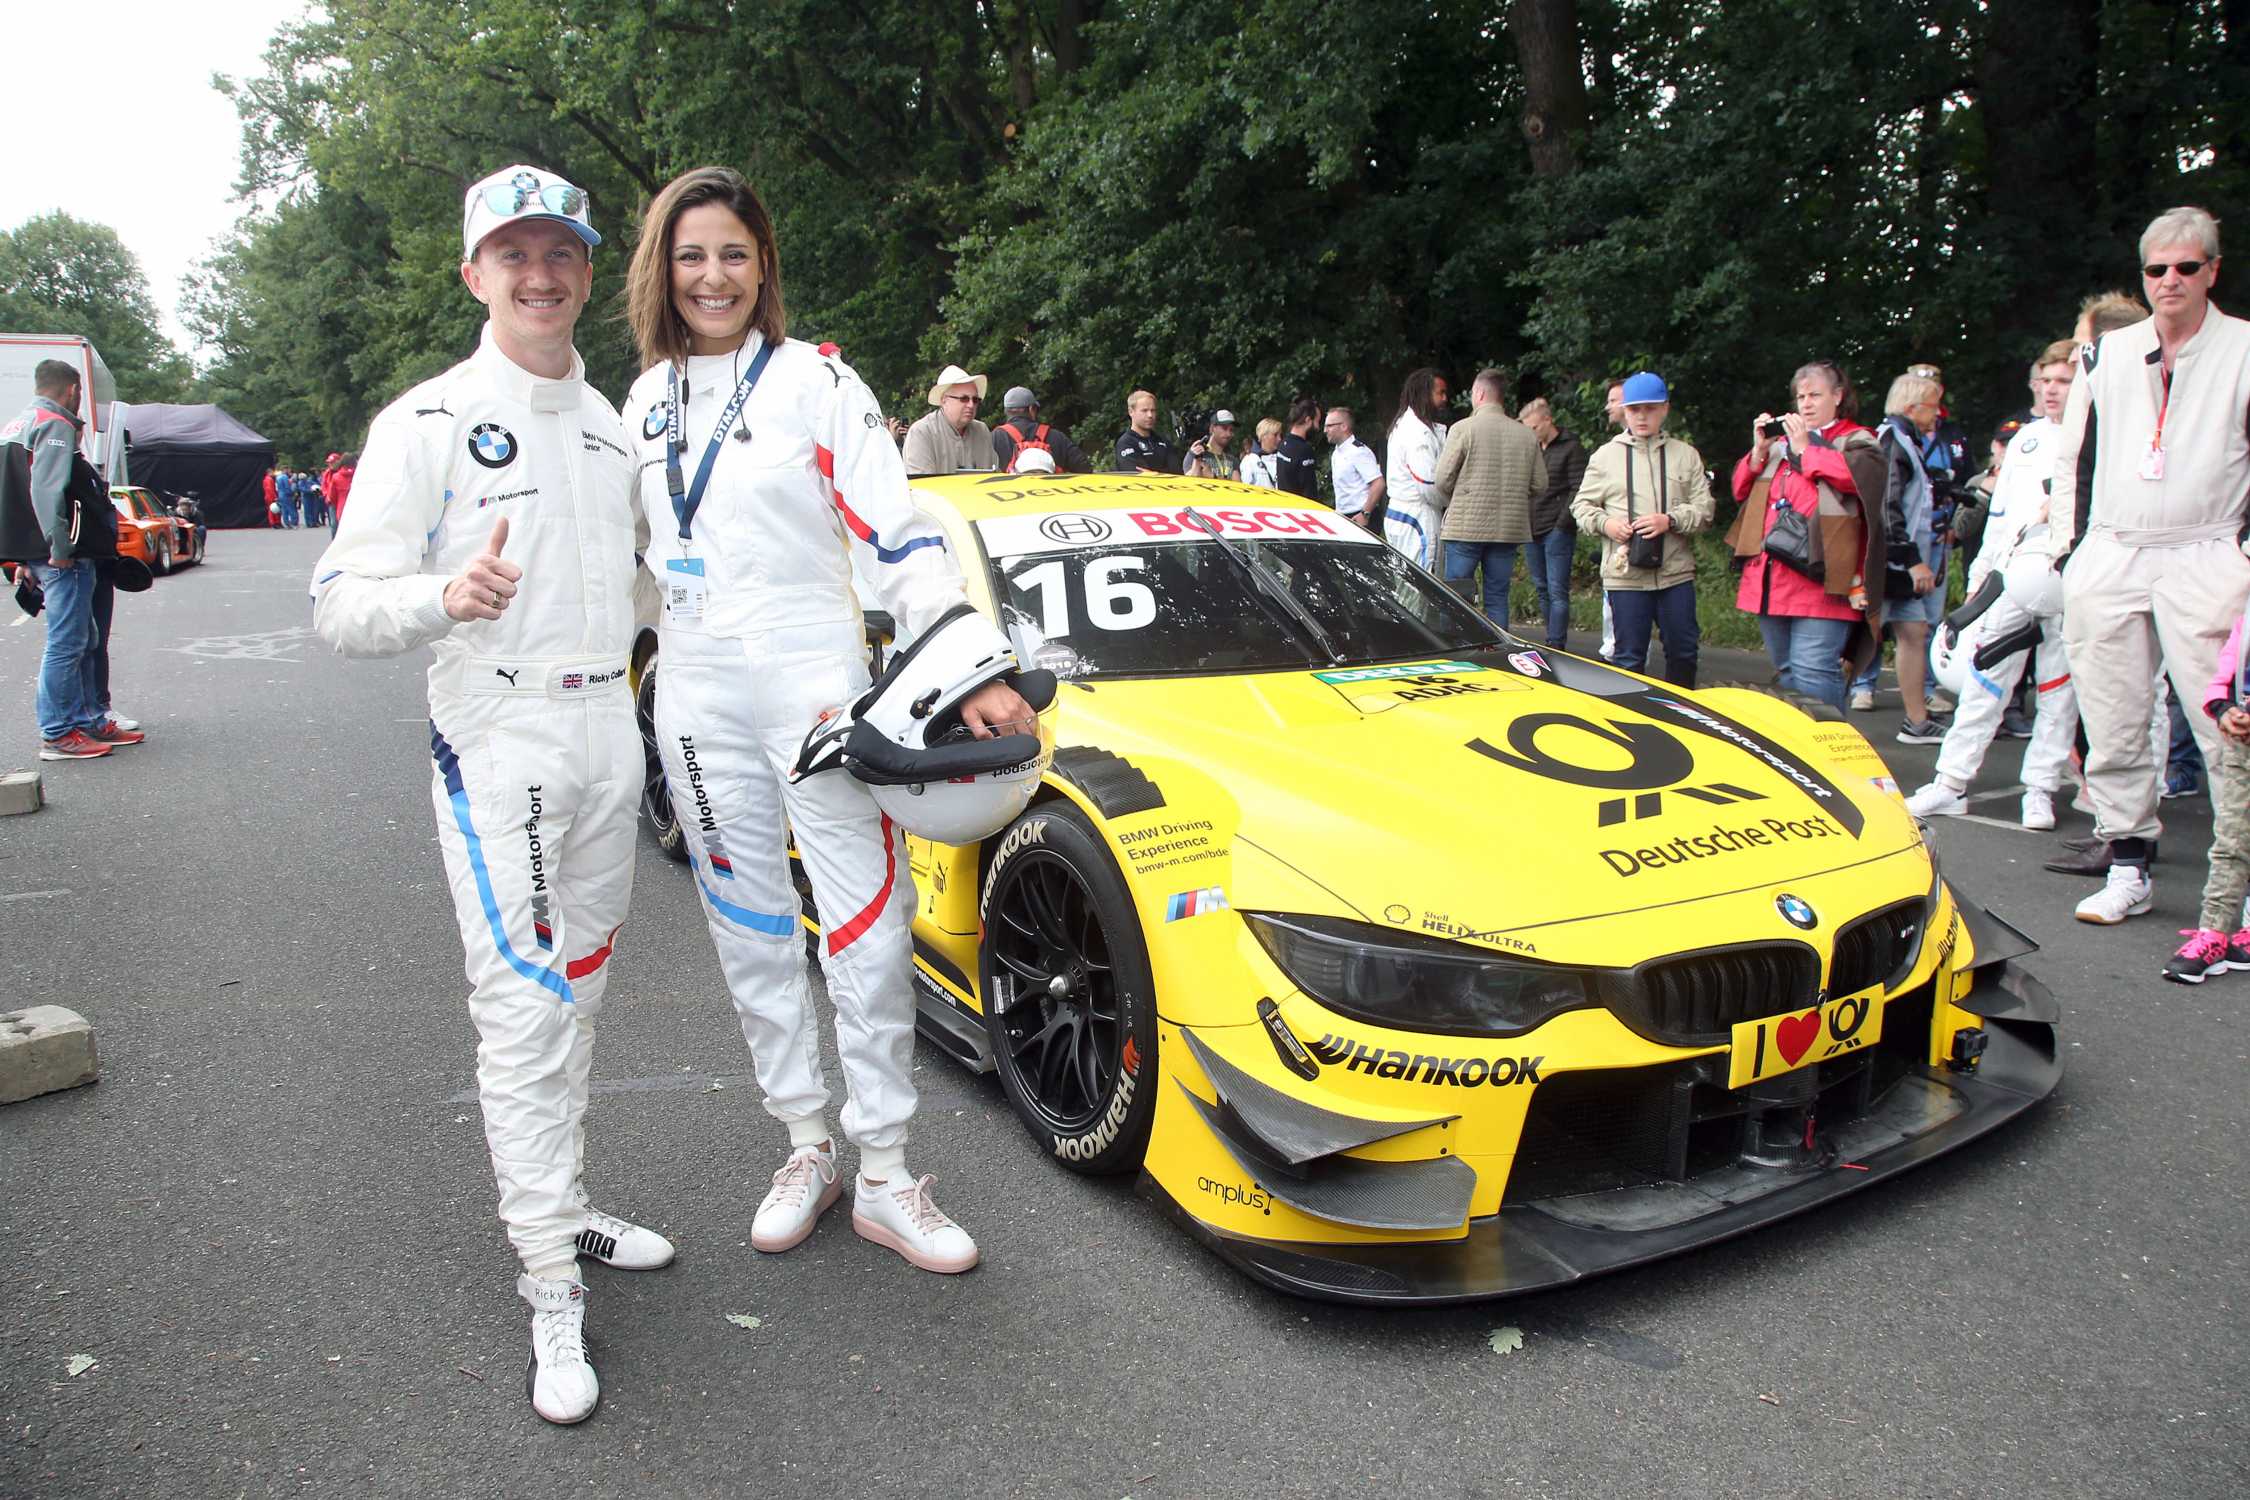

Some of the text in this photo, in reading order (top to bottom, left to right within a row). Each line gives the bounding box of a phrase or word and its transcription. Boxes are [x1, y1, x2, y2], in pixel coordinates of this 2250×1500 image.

[668, 383, 678, 442] DTM.COM
[713, 379, 752, 443] DTM.COM
[469, 423, 508, 441] BMW
[497, 488, 539, 502] Motorsport
[986, 482, 1190, 502] Deutsche
[1127, 511, 1338, 536] BOSCH
[1009, 554, 1157, 640] 16
[588, 674, 610, 684] Ricky
[1324, 663, 1479, 682] DEKRA
[1390, 675, 1460, 687] 16
[1393, 682, 1499, 701] ADAC
[1698, 718, 1832, 797] Motorsport
[679, 735, 717, 832] Motorsport
[525, 784, 547, 893] Motorsport
[1118, 819, 1213, 845] BMW Driving
[1127, 836, 1209, 861] Experience
[1599, 814, 1841, 878] Deutsche Post
[1136, 847, 1230, 875] bmw-m.com/bde
[1482, 935, 1537, 953] ULTRA
[1752, 1023, 1766, 1079] I
[535, 1287, 564, 1301] Ricky
